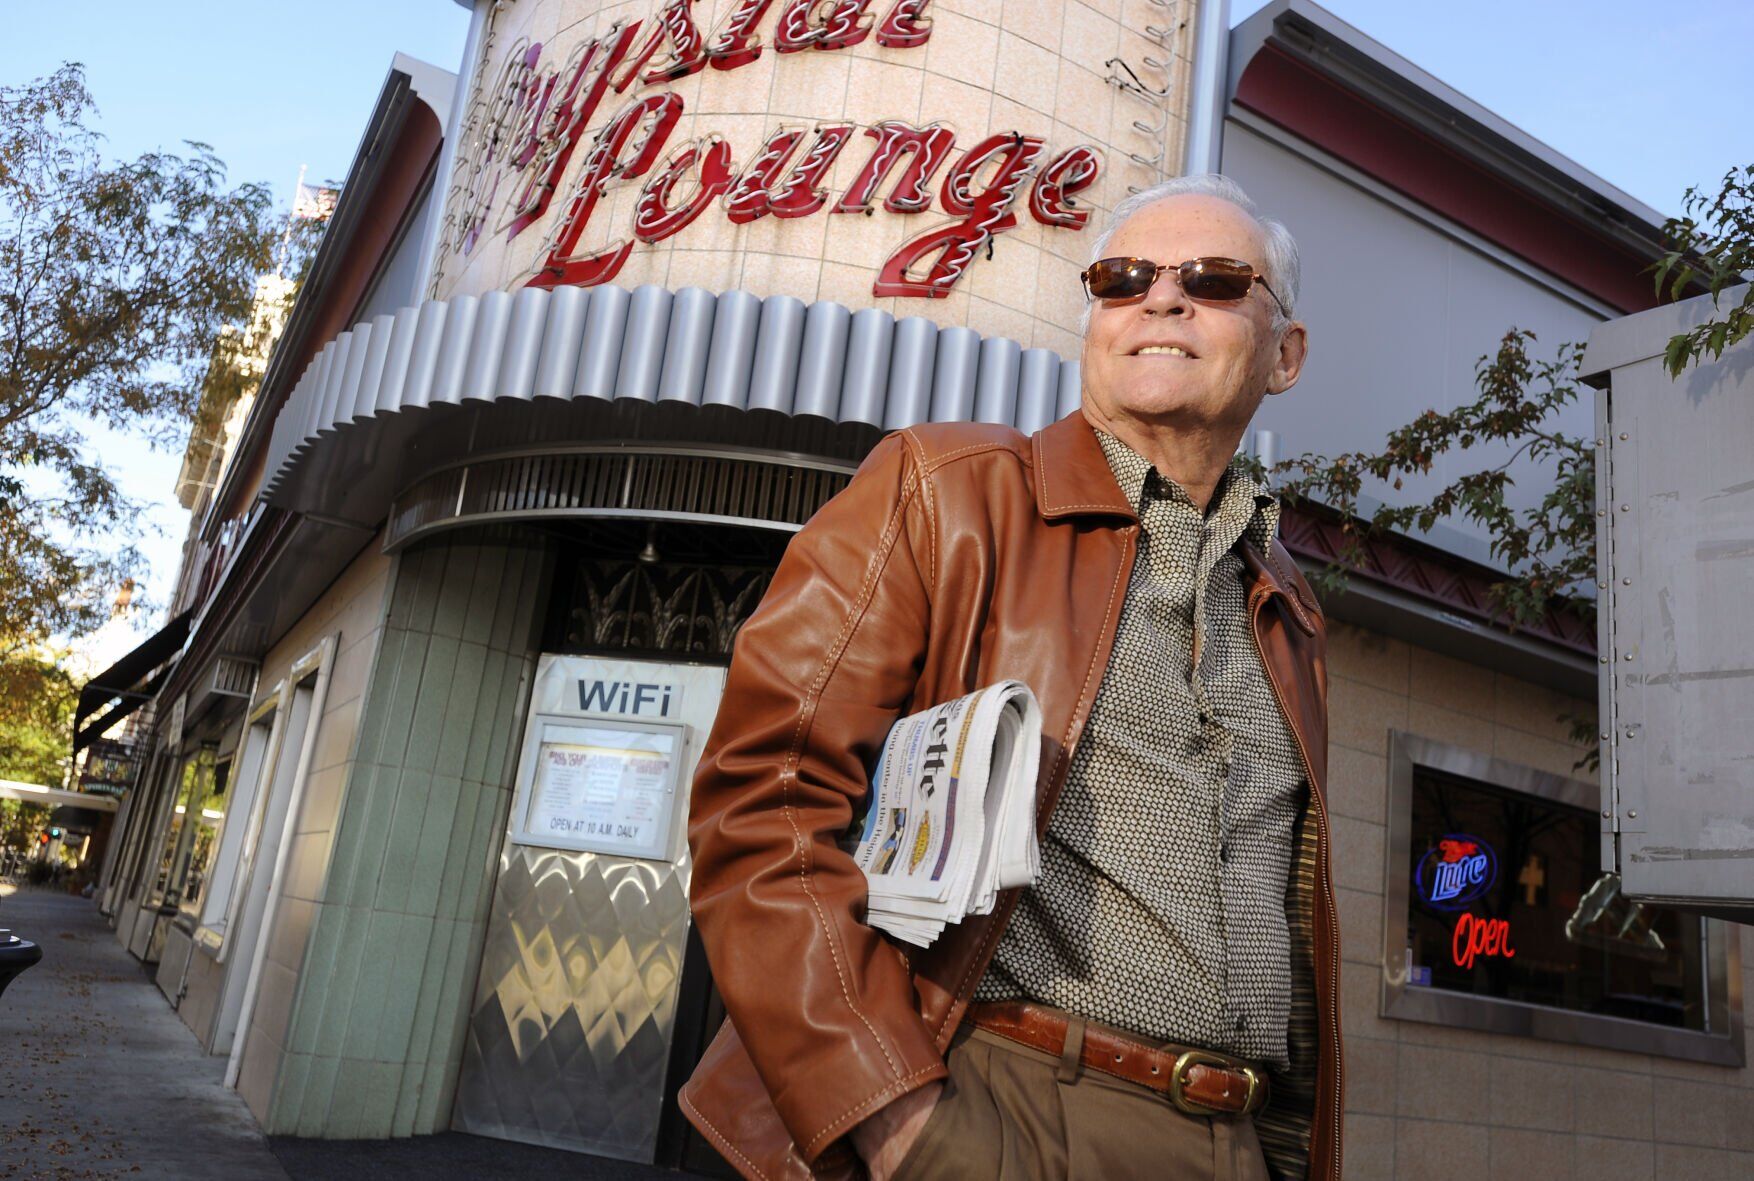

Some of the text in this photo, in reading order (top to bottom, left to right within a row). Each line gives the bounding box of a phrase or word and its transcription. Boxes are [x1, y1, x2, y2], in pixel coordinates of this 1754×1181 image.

[522, 88, 1100, 298] Lounge
[577, 679, 671, 717] WiFi
[880, 752, 893, 789] center
[878, 807, 887, 826] the
[879, 792, 887, 803] in
[550, 817, 571, 832] OPEN
[573, 820, 585, 833] AT
[587, 822, 596, 834] 10
[616, 824, 640, 839] DAILY
[860, 829, 883, 869] Heights
[1431, 854, 1487, 901] Lite
[1452, 912, 1515, 970] Open
